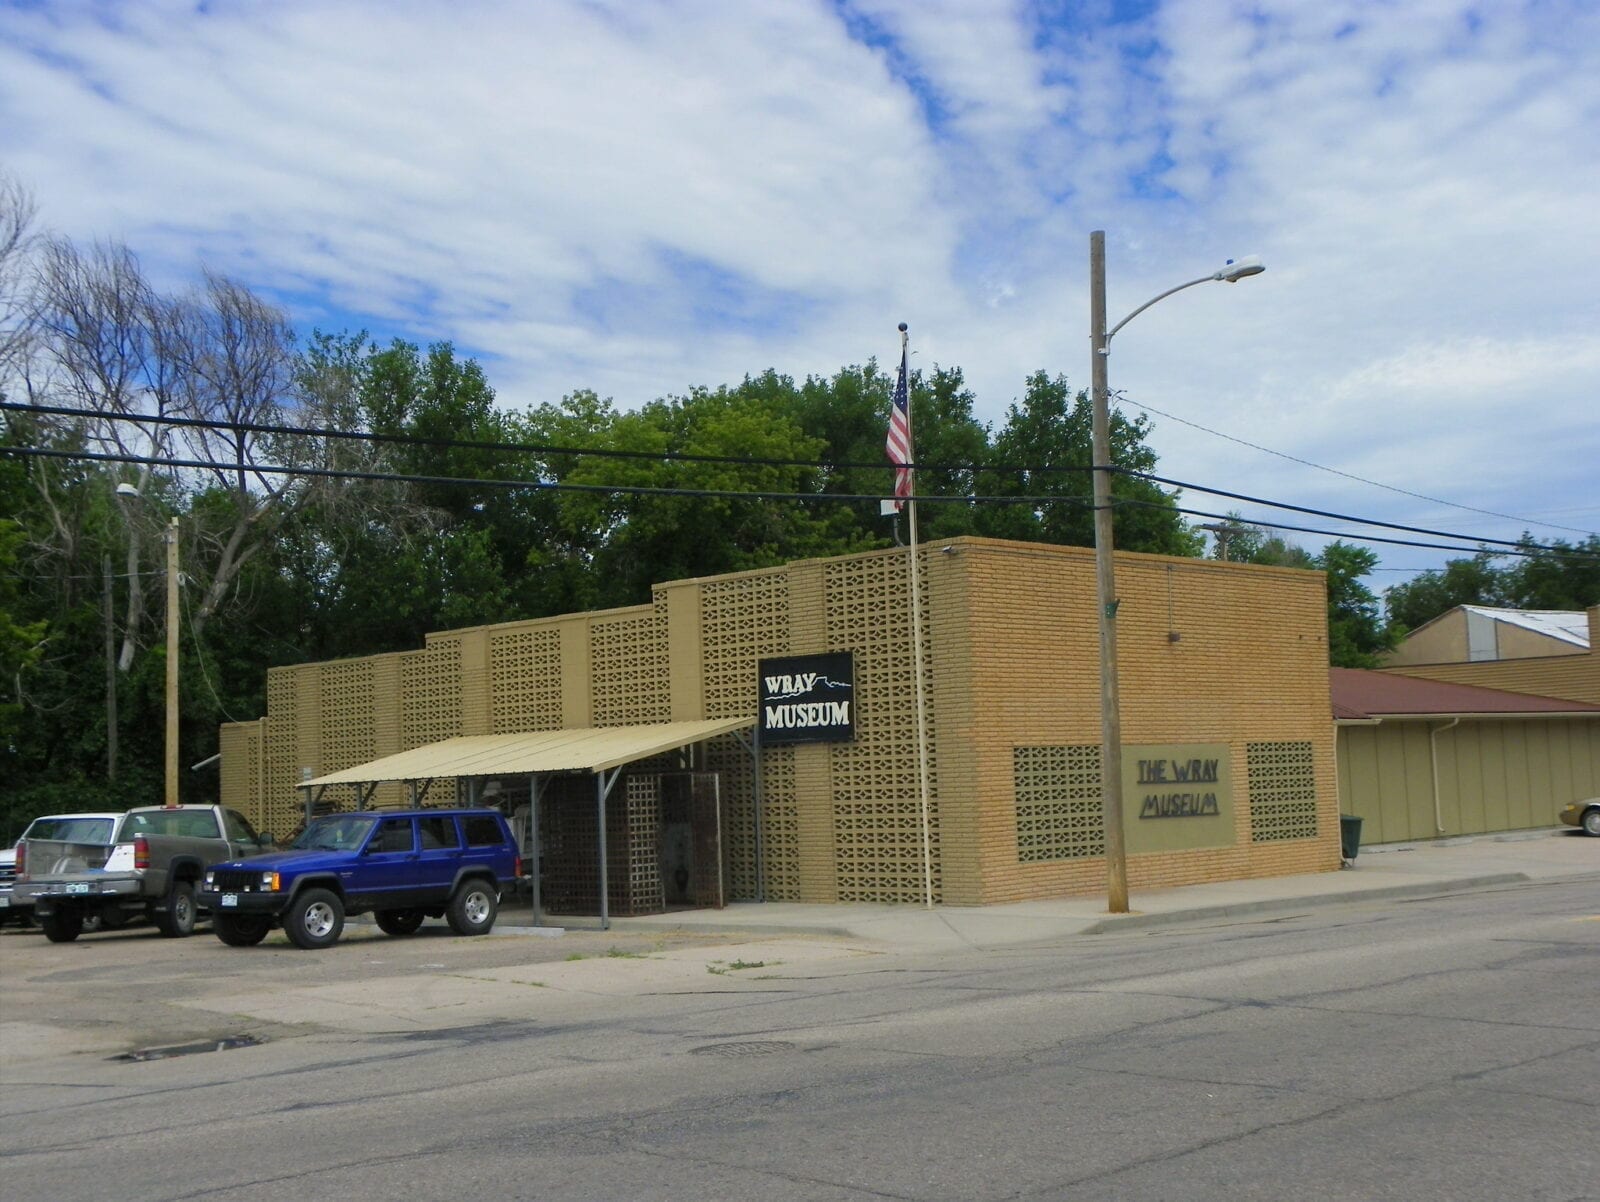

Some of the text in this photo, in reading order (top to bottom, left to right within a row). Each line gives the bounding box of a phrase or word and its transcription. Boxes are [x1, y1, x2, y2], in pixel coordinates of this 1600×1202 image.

[765, 673, 816, 694] WRAY
[765, 701, 849, 729] MUSEUM
[1138, 759, 1219, 782] THE WRAY
[1140, 793, 1219, 818] MUSEUM
